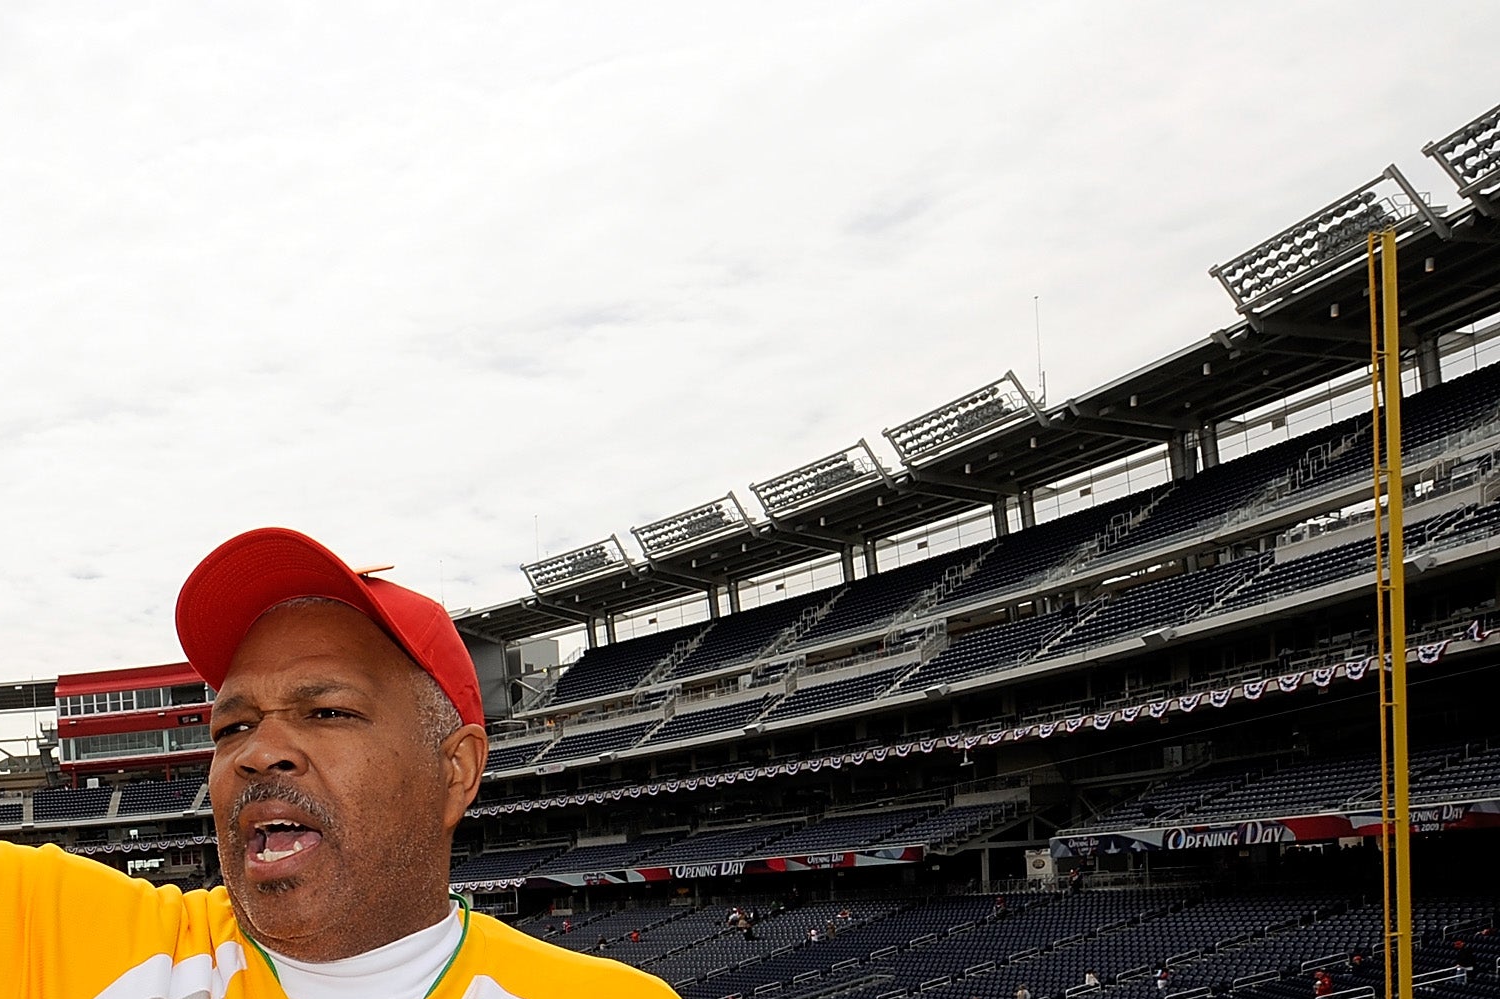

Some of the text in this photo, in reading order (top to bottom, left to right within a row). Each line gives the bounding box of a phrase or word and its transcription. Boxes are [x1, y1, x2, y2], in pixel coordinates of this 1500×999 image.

[1409, 804, 1465, 822] PENING DAY
[1167, 820, 1284, 849] OPENING DAY
[675, 861, 745, 879] OPENING DAY
